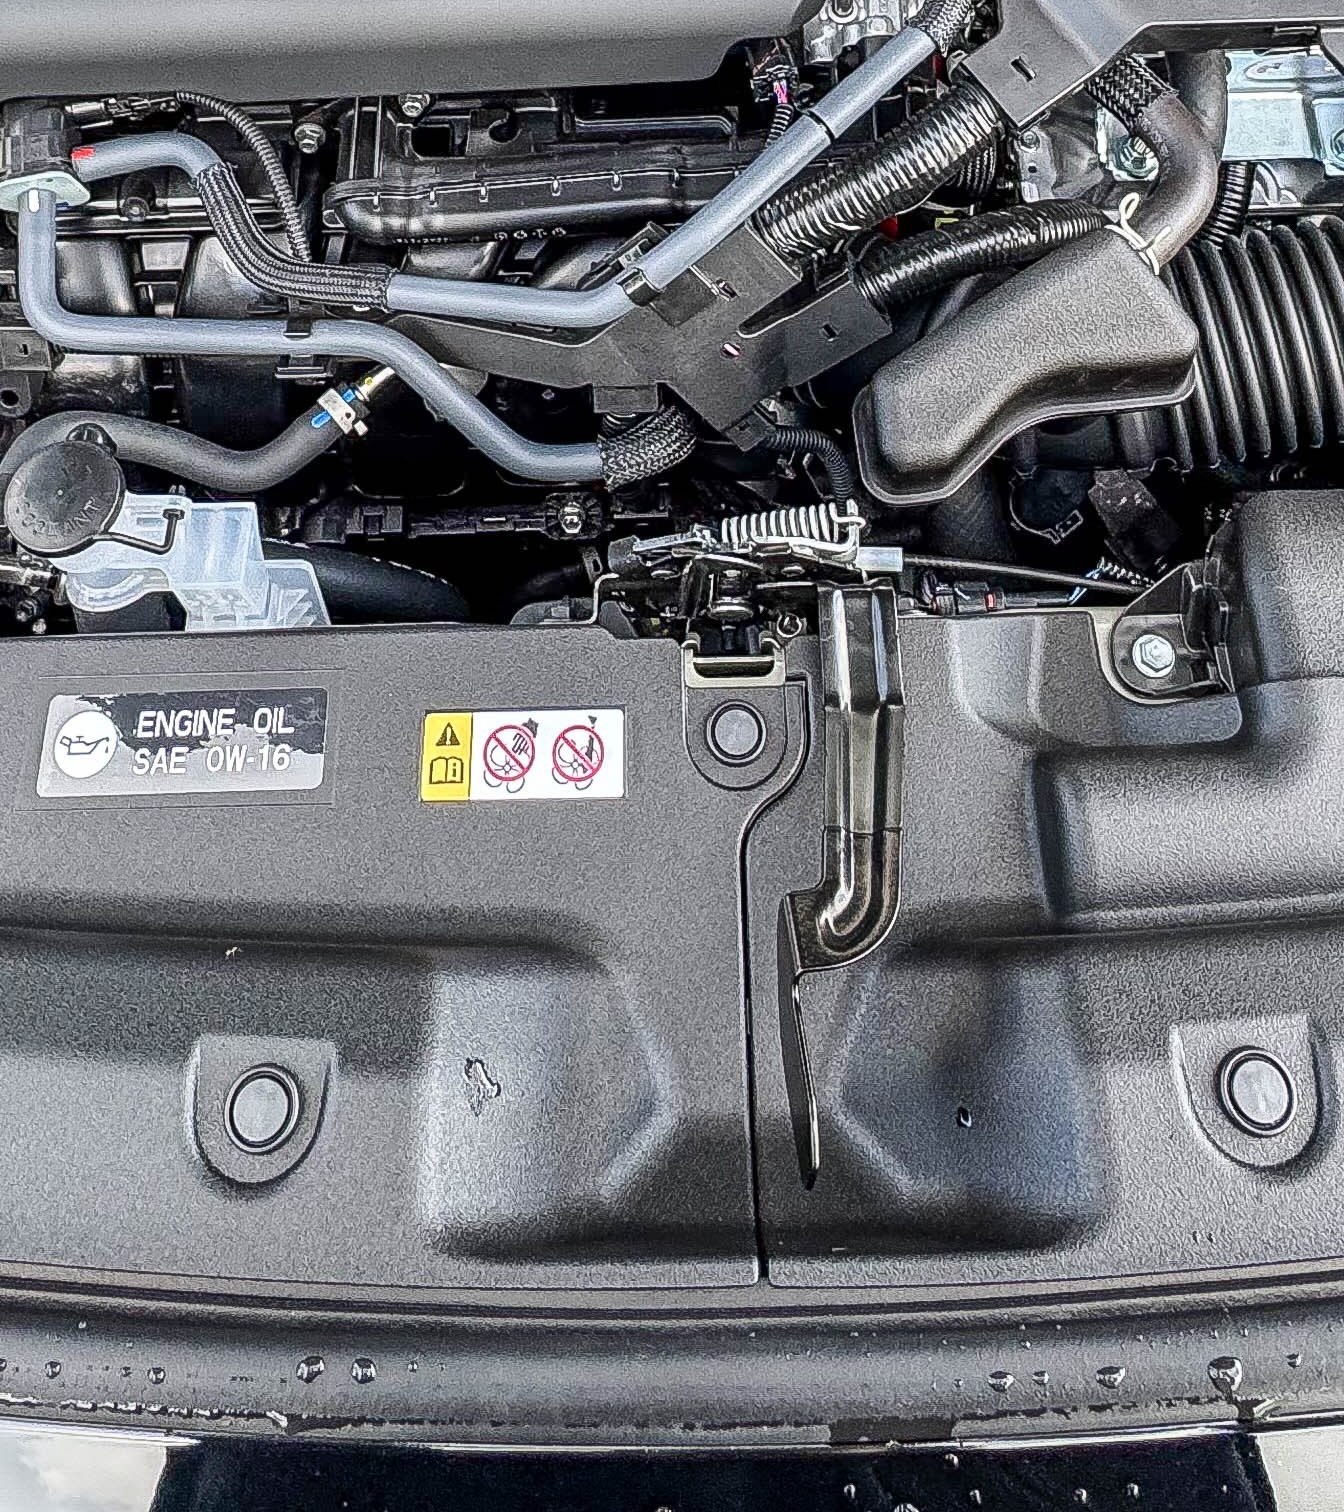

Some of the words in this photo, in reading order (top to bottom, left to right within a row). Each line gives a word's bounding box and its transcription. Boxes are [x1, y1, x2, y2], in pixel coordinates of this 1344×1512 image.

[136, 708, 236, 738] ENGINE
[254, 707, 295, 735] OIL
[132, 746, 190, 776] SAE
